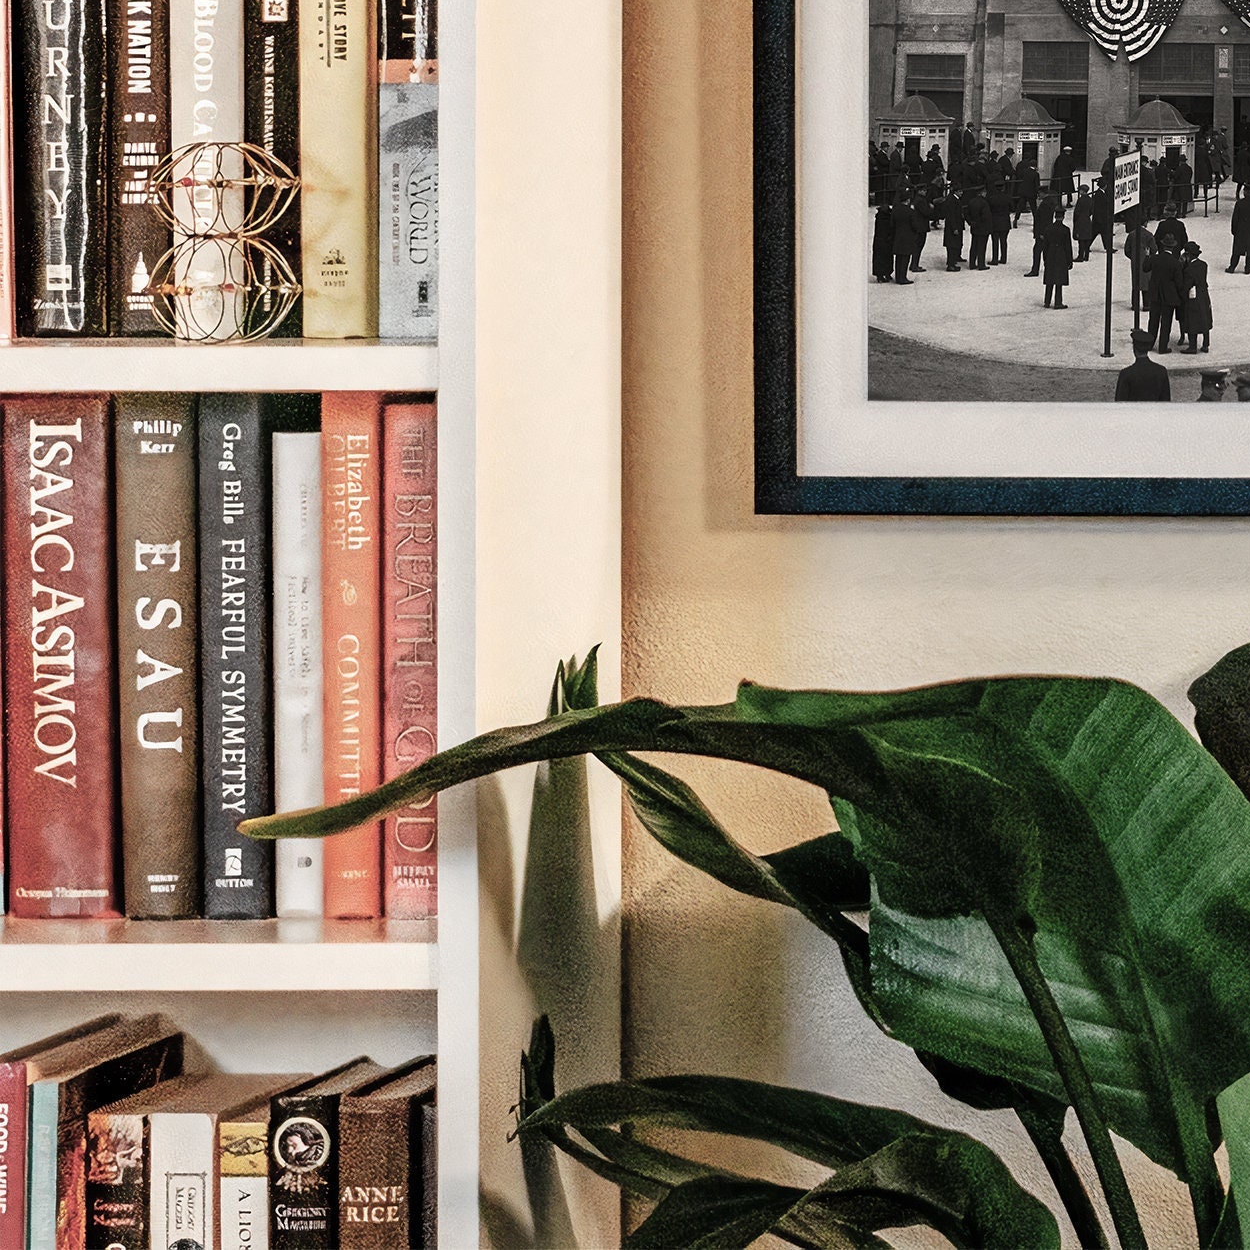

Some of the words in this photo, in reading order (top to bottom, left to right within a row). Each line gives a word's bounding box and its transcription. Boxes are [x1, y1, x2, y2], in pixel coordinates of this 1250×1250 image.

[127, 7, 152, 95] NATION
[334, 24, 347, 62] STORY
[132, 419, 183, 437] Philip
[140, 440, 176, 455] Kerr
[218, 422, 242, 471] Greg
[28, 417, 82, 573] ISAAC
[222, 479, 245, 525] Bills
[347, 433, 371, 551] Elizabeth
[221, 538, 246, 660] FEARFUL
[395, 495, 434, 666] BREATH
[31, 578, 85, 789] ASIMOV
[134, 538, 184, 753] ESAU
[221, 667, 246, 815] SYMMETRY
[337, 634, 361, 799] COMMITTE
[238, 1188, 252, 1203] A
[341, 1185, 404, 1203] ANNE
[346, 1204, 400, 1223] RICE
